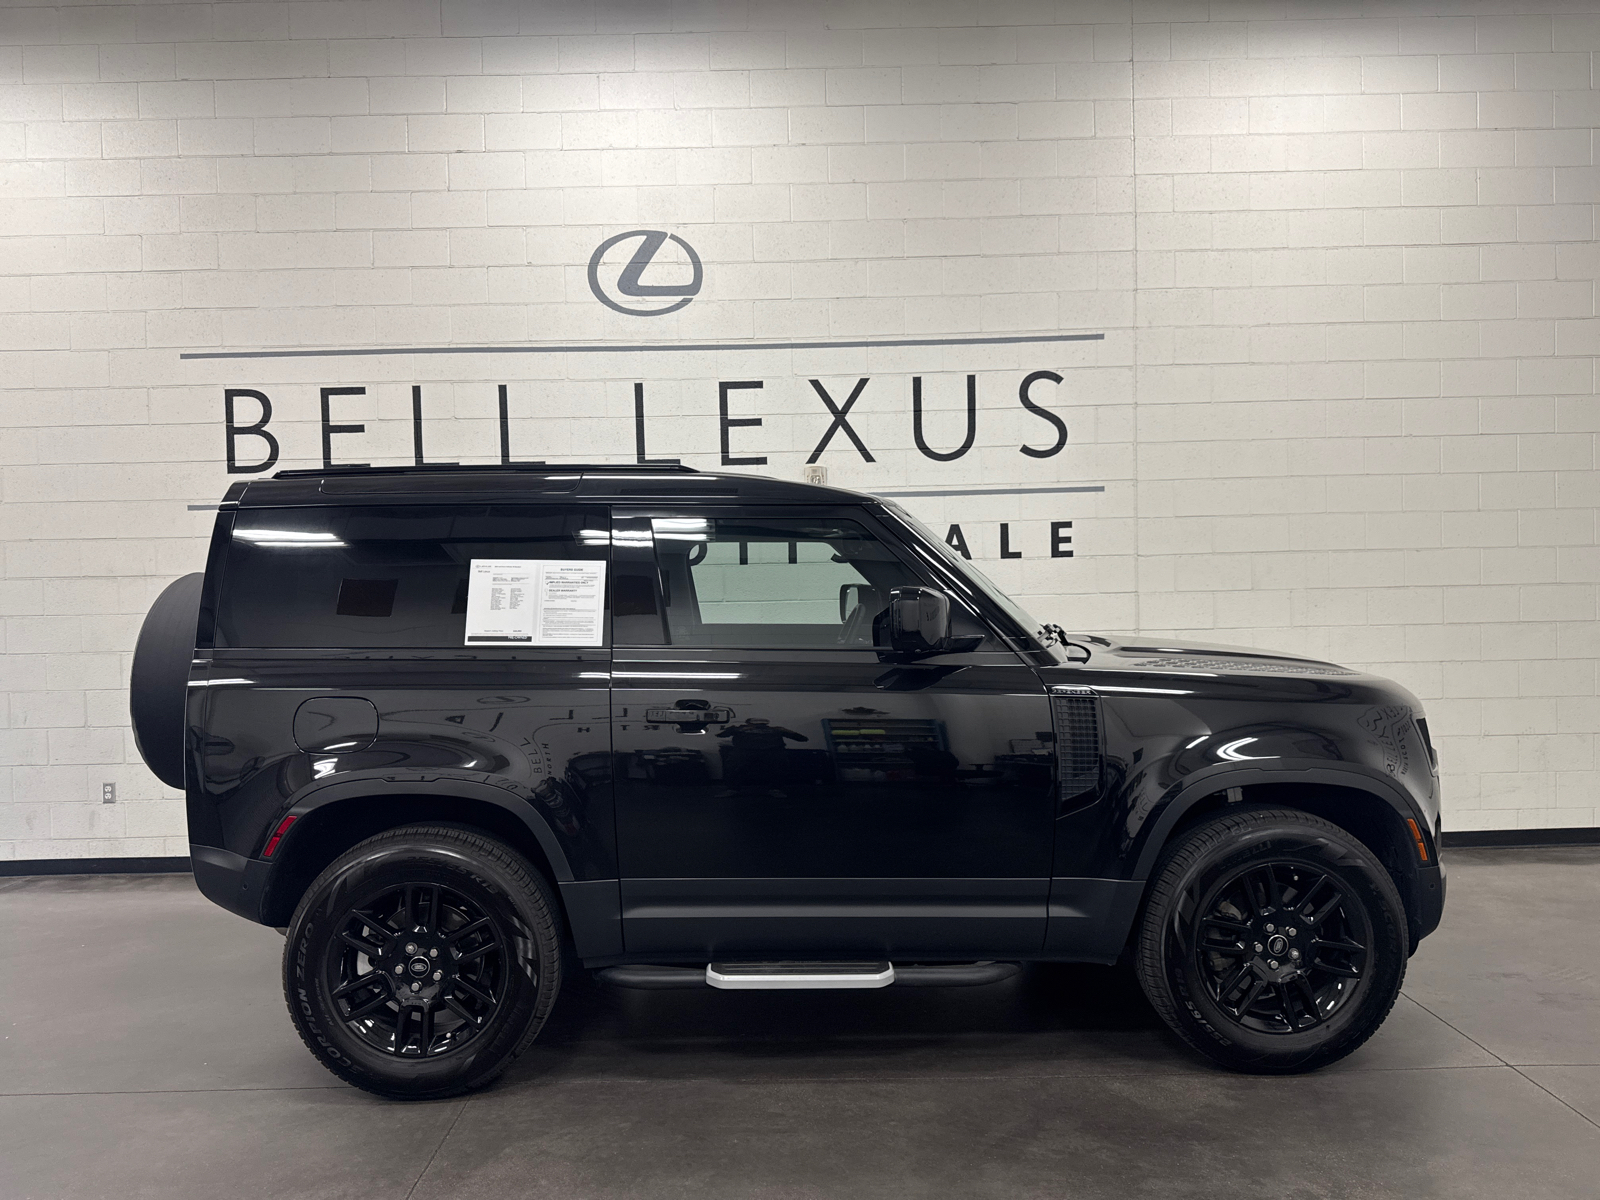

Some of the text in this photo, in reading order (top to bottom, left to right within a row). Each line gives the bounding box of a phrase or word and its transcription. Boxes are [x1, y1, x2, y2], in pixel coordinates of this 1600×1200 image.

[224, 370, 1069, 474] BELL LEXUS
[295, 921, 315, 982] ZERO
